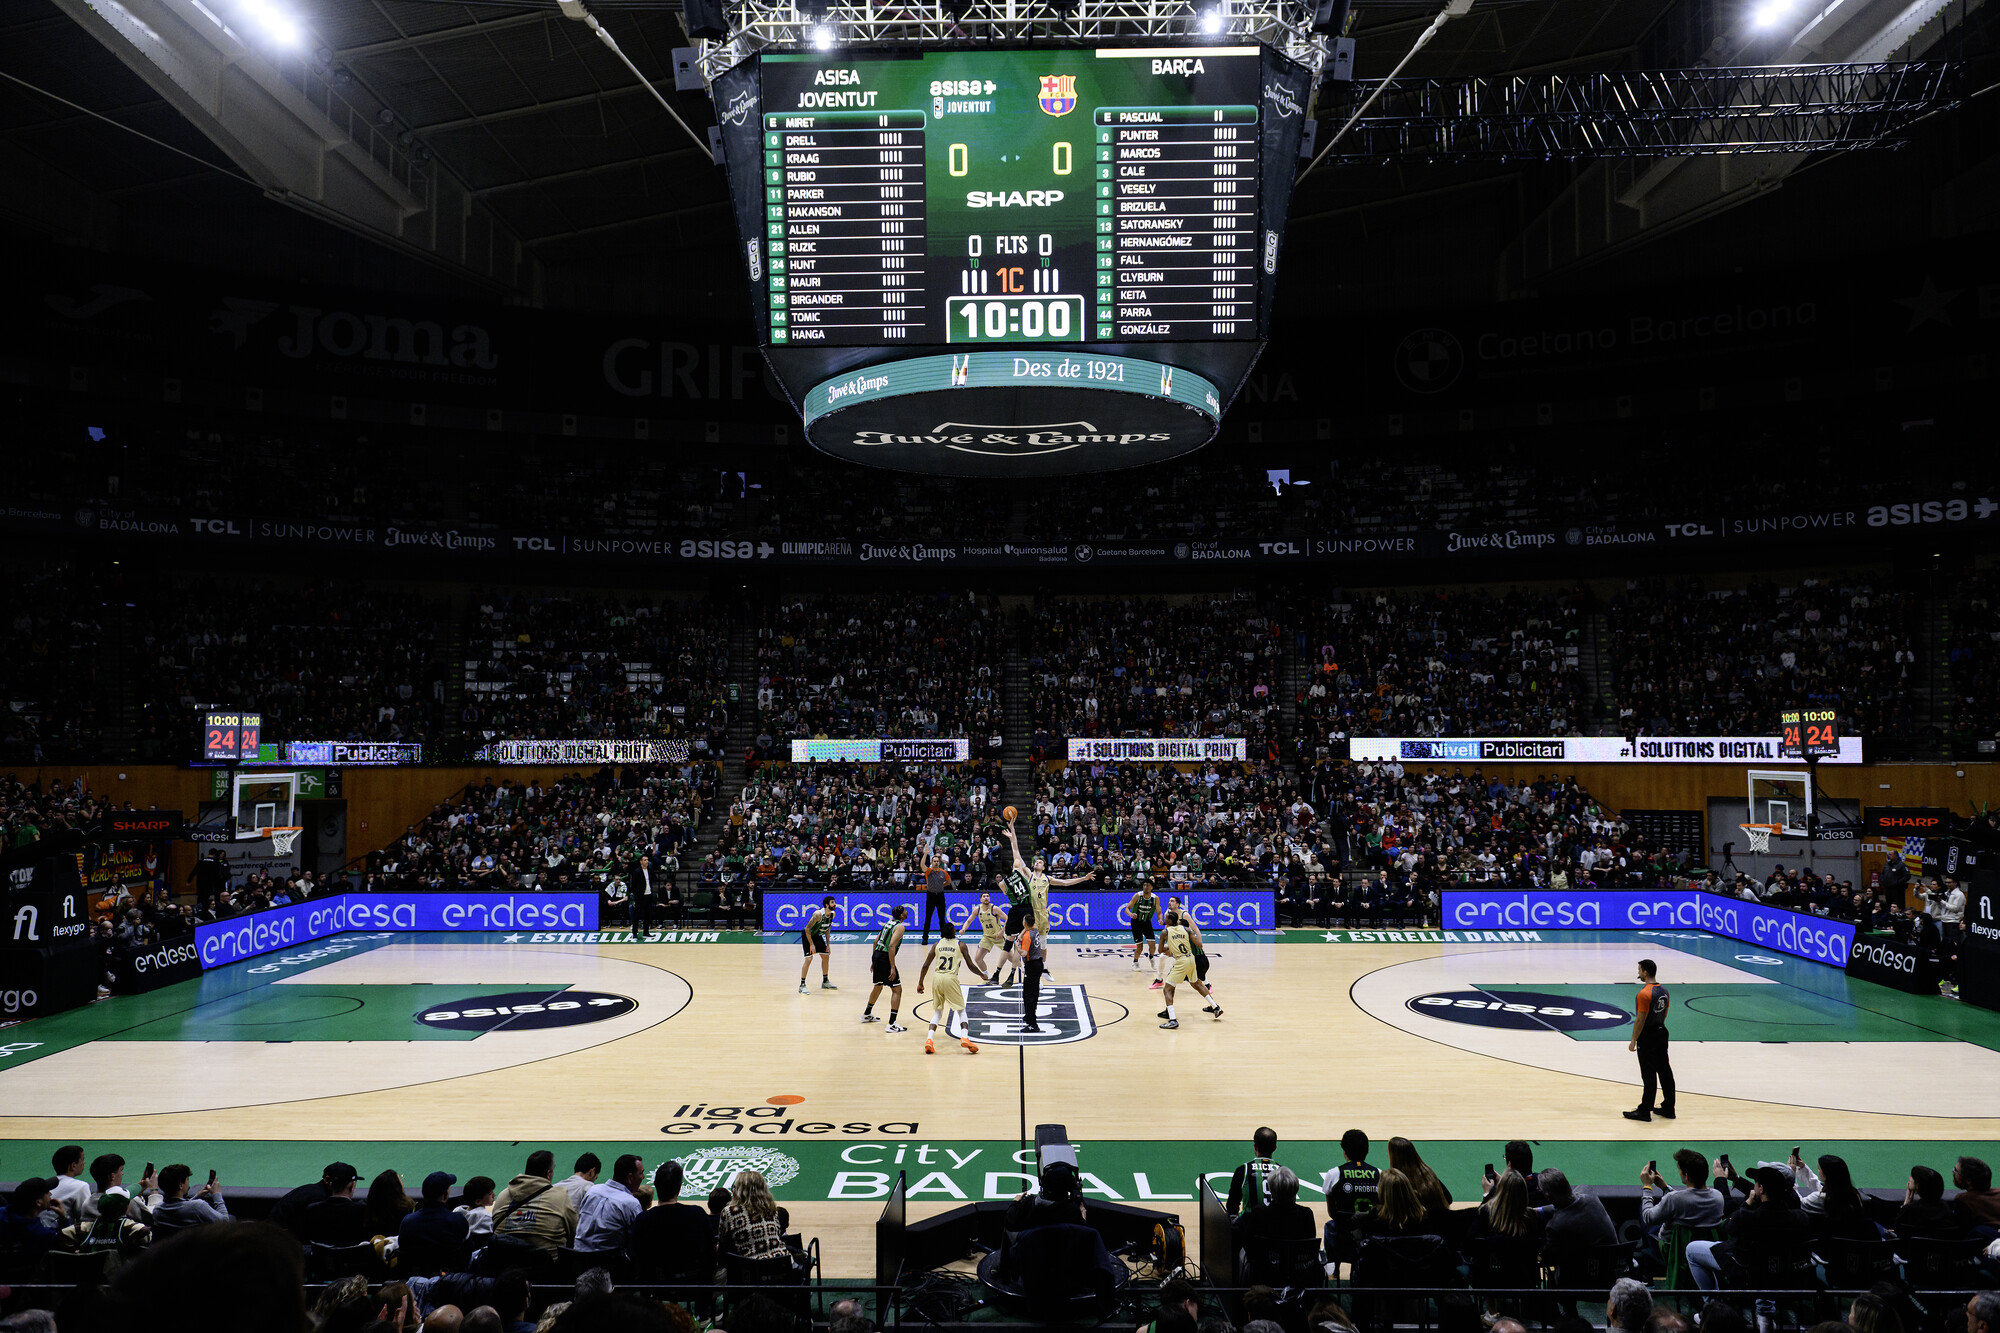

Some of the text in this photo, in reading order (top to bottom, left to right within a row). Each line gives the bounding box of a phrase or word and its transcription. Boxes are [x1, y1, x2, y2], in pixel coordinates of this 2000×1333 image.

[1152, 59, 1205, 77] BARÇA
[814, 69, 860, 86] ASISA
[798, 91, 878, 108] JOVENTUT
[947, 101, 992, 113] JOVENTUT
[770, 117, 815, 128] E MIRET
[1104, 113, 1163, 122] E PASCUAL
[771, 135, 816, 146] 0 DRELL
[1102, 130, 1158, 142] 0 PUNTER
[773, 154, 820, 165] 1 KRAAG
[949, 143, 968, 177] 0
[1053, 141, 1072, 175] 0
[1102, 148, 1160, 160] 2 MARCOS
[772, 171, 816, 182] 9 RUBIO
[1102, 166, 1145, 178] 3 CALE
[770, 190, 824, 200] 11 PARKER
[1102, 184, 1156, 196] 6 VESELY
[966, 189, 1064, 208] SHARP
[771, 207, 841, 218] 12 HAKANSON
[1102, 202, 1166, 214] 8 BRIZUELA
[771, 225, 820, 235] 21 ALLEN
[1100, 219, 1183, 231] 13 SATORANSKY
[772, 242, 817, 253] 23 RUZIC
[969, 233, 1052, 257] 0 FLTS 0
[1100, 235, 1192, 250] 14 HERNANGÓMEZ
[772, 260, 816, 270] 24 HUNT
[969, 258, 980, 269] TO
[1040, 257, 1050, 268] TO
[1100, 255, 1144, 267] 19 FALL
[773, 278, 820, 288] 32 MAURI
[996, 267, 1024, 293] 1C
[1100, 272, 1163, 284] 21 CLYBURN
[773, 295, 843, 305] 35 BIRGANDER
[1099, 290, 1147, 302] 41 KEITA
[774, 312, 820, 322] 44 TOMIC
[960, 300, 1071, 338] 10:00
[1099, 308, 1152, 320] 44 PARRA
[774, 329, 825, 340] 88 HANGA
[1099, 323, 1170, 337] 47 GONZÁLEZ
[1479, 325, 1617, 360] Caetano
[1630, 302, 1816, 344] Barcelona
[278, 305, 498, 371] Joma
[1012, 357, 1125, 382] Des de 1921
[391, 368, 497, 387] YOUR FREEDOM
[9, 507, 61, 521] Barcelona
[100, 518, 178, 535] BADALONA
[190, 518, 240, 535] TCL
[1733, 511, 1855, 534] SUNPOWER
[260, 523, 375, 543] SUNPOWER
[1665, 522, 1714, 538] TCL
[512, 537, 556, 551] TCL
[1316, 538, 1415, 553] SUNPOWER
[1586, 531, 1656, 546] BADALONA
[572, 539, 672, 555] SUNPOWER
[963, 543, 1068, 558] Hospital quironsalud
[1097, 547, 1165, 556] Caetano Barcelona
[1191, 540, 1218, 553] City of
[1259, 541, 1300, 555] TCL
[1192, 549, 1251, 560] BADALONA
[208, 715, 239, 726] 10:00
[242, 715, 260, 727] 10:00
[1781, 713, 1800, 724] 10:00
[1803, 710, 1836, 722] 10:00
[208, 730, 235, 749] 24
[242, 730, 258, 749] 24
[1784, 727, 1801, 746] 24
[1807, 725, 1836, 746] 24
[884, 742, 954, 759] Publicitari
[1093, 743, 1237, 758] SOLUTIONS DIGITAL PRINT
[1431, 741, 1563, 759] Nivell Publicitari
[1639, 741, 1715, 758] SOLUTIONS
[1719, 741, 1774, 758] DIGITAL
[113, 821, 170, 831] SHARP
[1879, 817, 1940, 827] SHARP
[1816, 830, 1854, 840] ndesa
[309, 895, 417, 935] endesa
[443, 896, 585, 928] endesa
[1454, 895, 1600, 926] endesa
[1627, 895, 1739, 935] endesa
[53, 923, 86, 938] flexygo
[529, 932, 637, 943] ESTRELLA
[1350, 931, 1543, 942] ESTRELLA DAMM
[1753, 910, 1847, 964] endesa
[202, 918, 294, 964] endesa
[136, 942, 197, 973] endesa
[1852, 938, 1917, 974] endesa
[939, 957, 953, 970] 21
[673, 1103, 789, 1120] liga
[660, 1119, 920, 1135] endesa
[840, 1144, 982, 1169] City
[1344, 1169, 1376, 1179] RICKY
